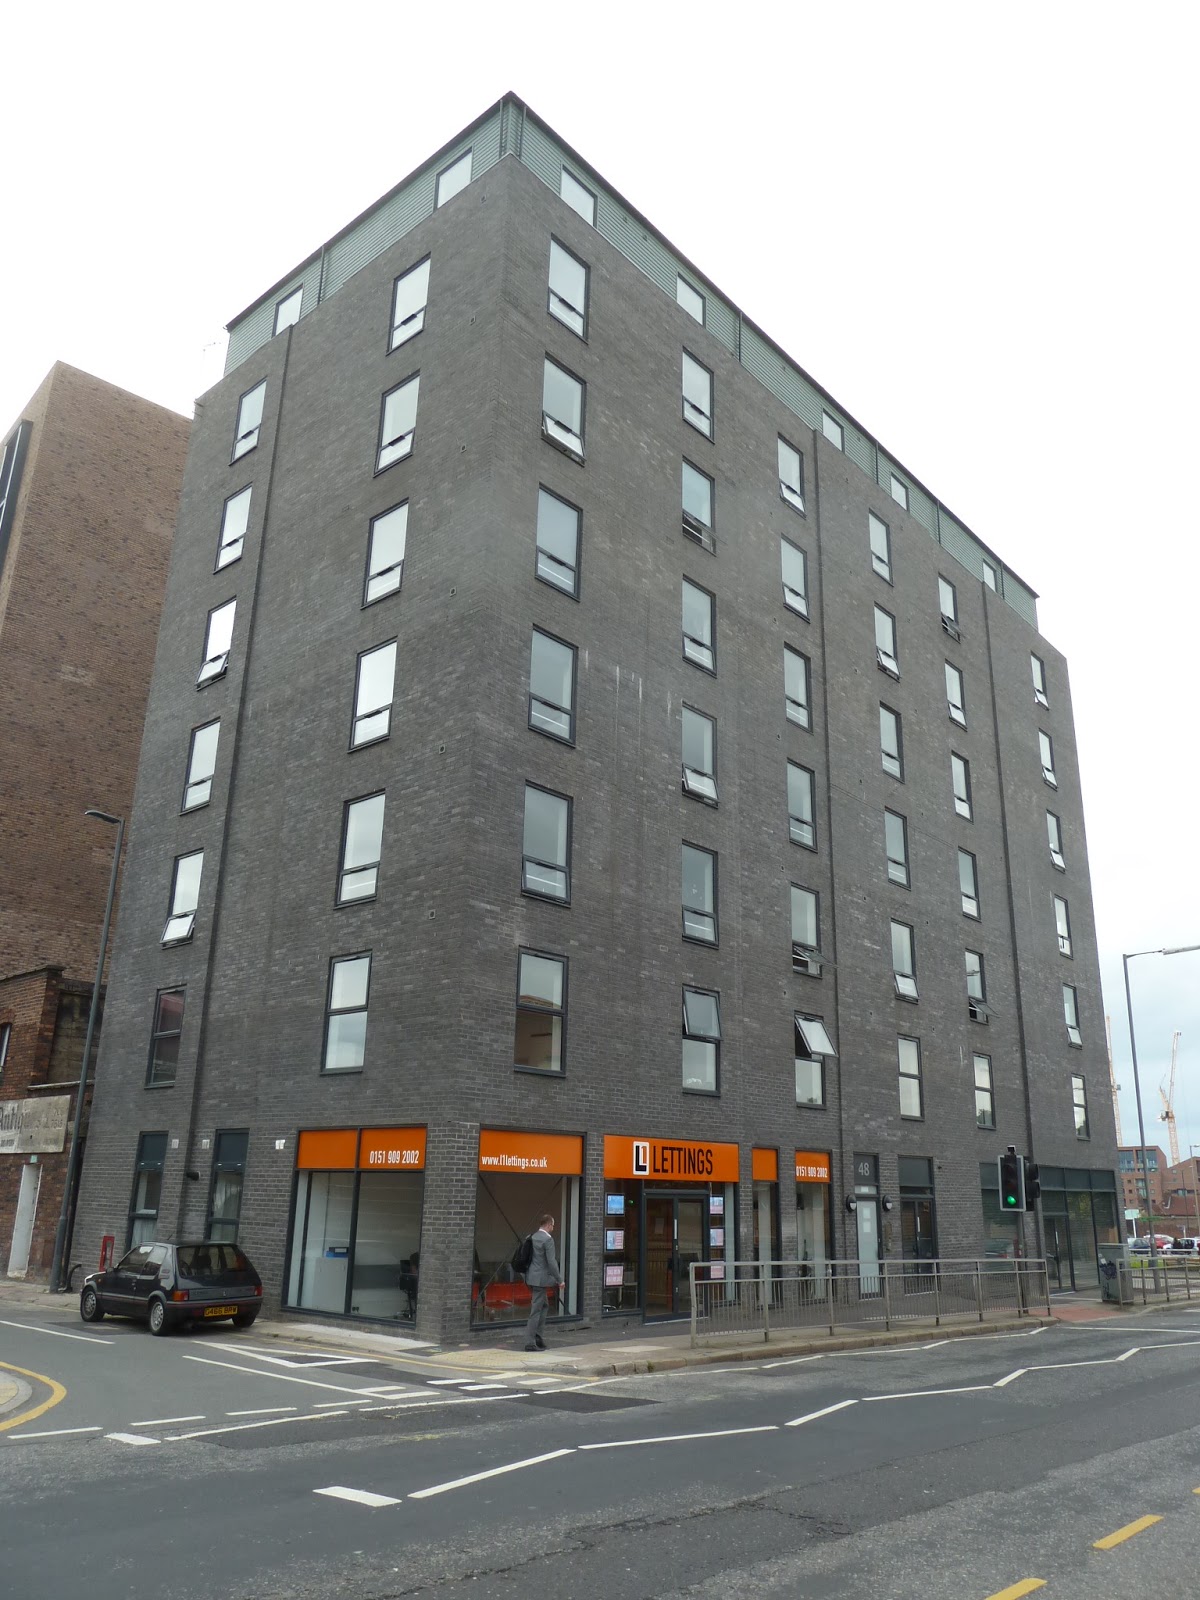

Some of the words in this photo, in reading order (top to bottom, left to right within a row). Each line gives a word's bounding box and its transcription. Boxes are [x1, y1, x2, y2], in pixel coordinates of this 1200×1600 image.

[369, 1150, 386, 1164] 0151
[388, 1150, 401, 1164] 909
[402, 1149, 420, 1164] 2002
[481, 1154, 548, 1170] www.l1lettings.co.uk
[653, 1145, 713, 1176] LETTINGS
[796, 1165, 807, 1177] 0151
[808, 1166, 817, 1178] 909
[858, 1162, 870, 1176] 48
